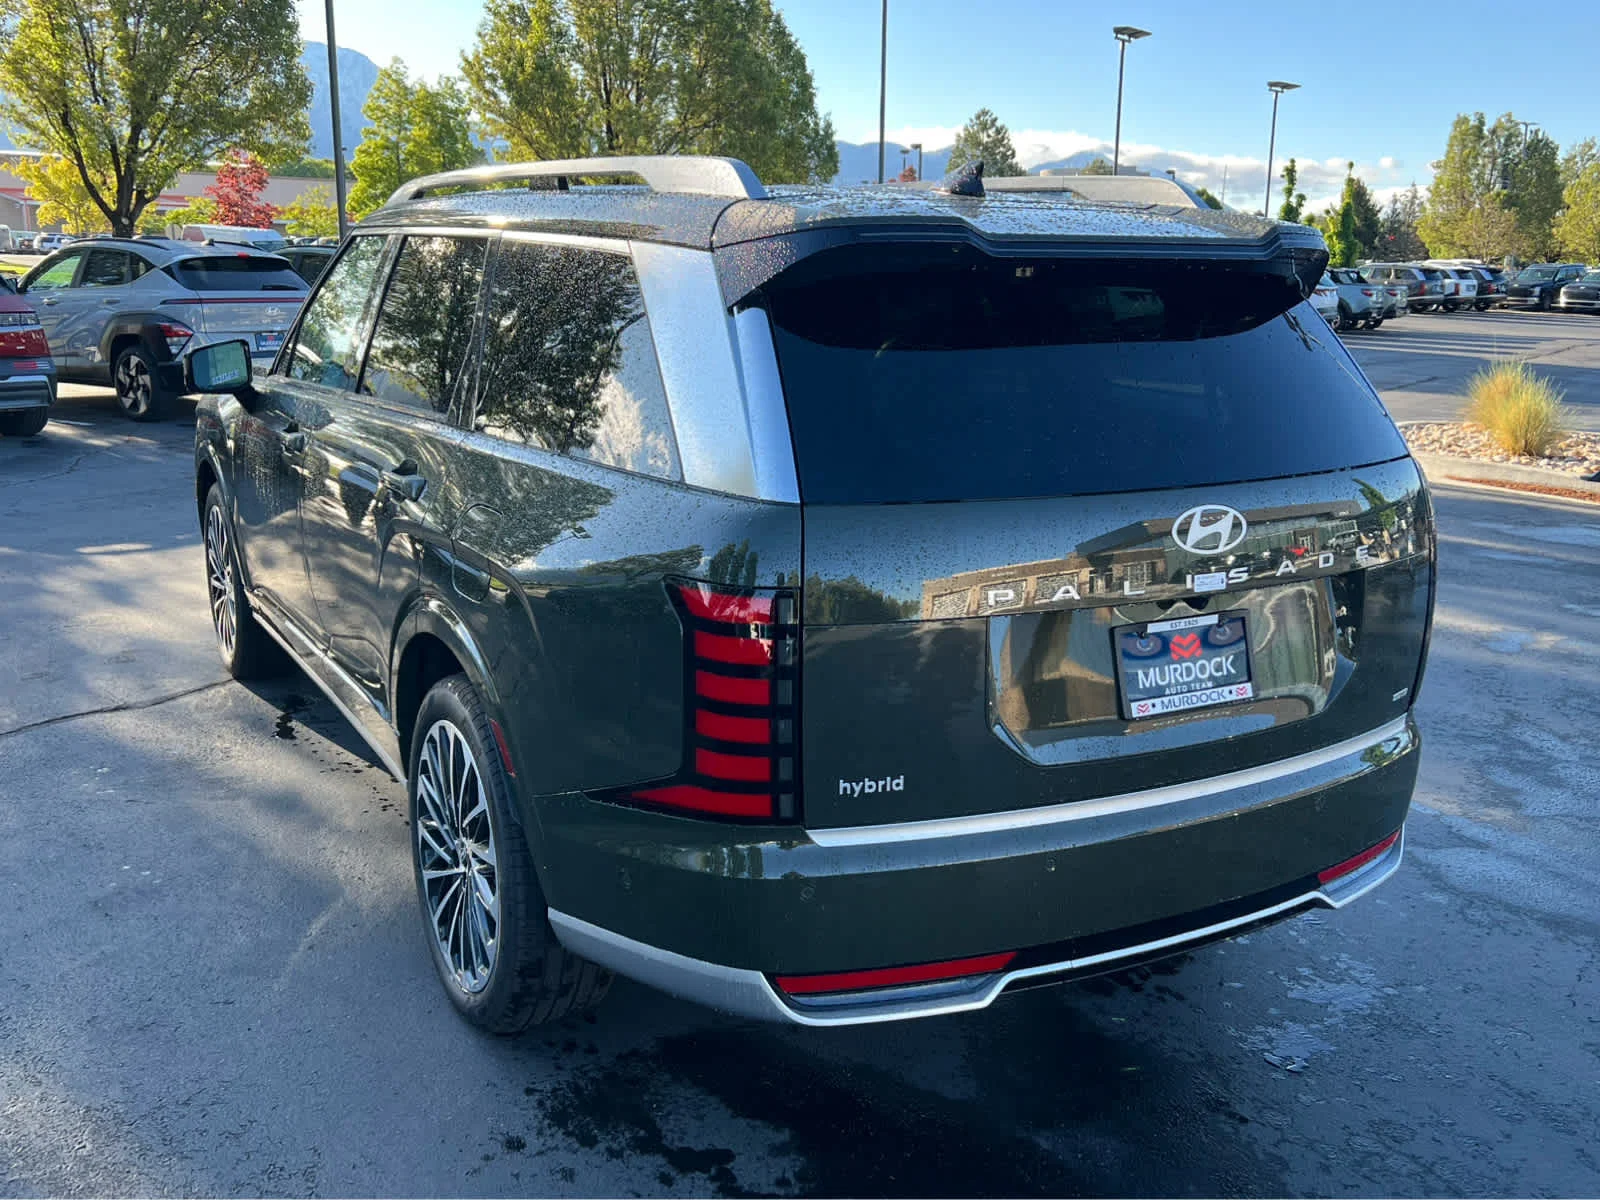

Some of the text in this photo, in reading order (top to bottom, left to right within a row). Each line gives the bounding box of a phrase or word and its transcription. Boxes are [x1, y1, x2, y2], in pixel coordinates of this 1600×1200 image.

[987, 545, 1370, 606] PALISADE
[1138, 655, 1237, 689] MURDOCK
[1160, 689, 1225, 710] MURDOCK
[1165, 681, 1213, 695] AUTO TEAM
[839, 775, 904, 798] hybrid
